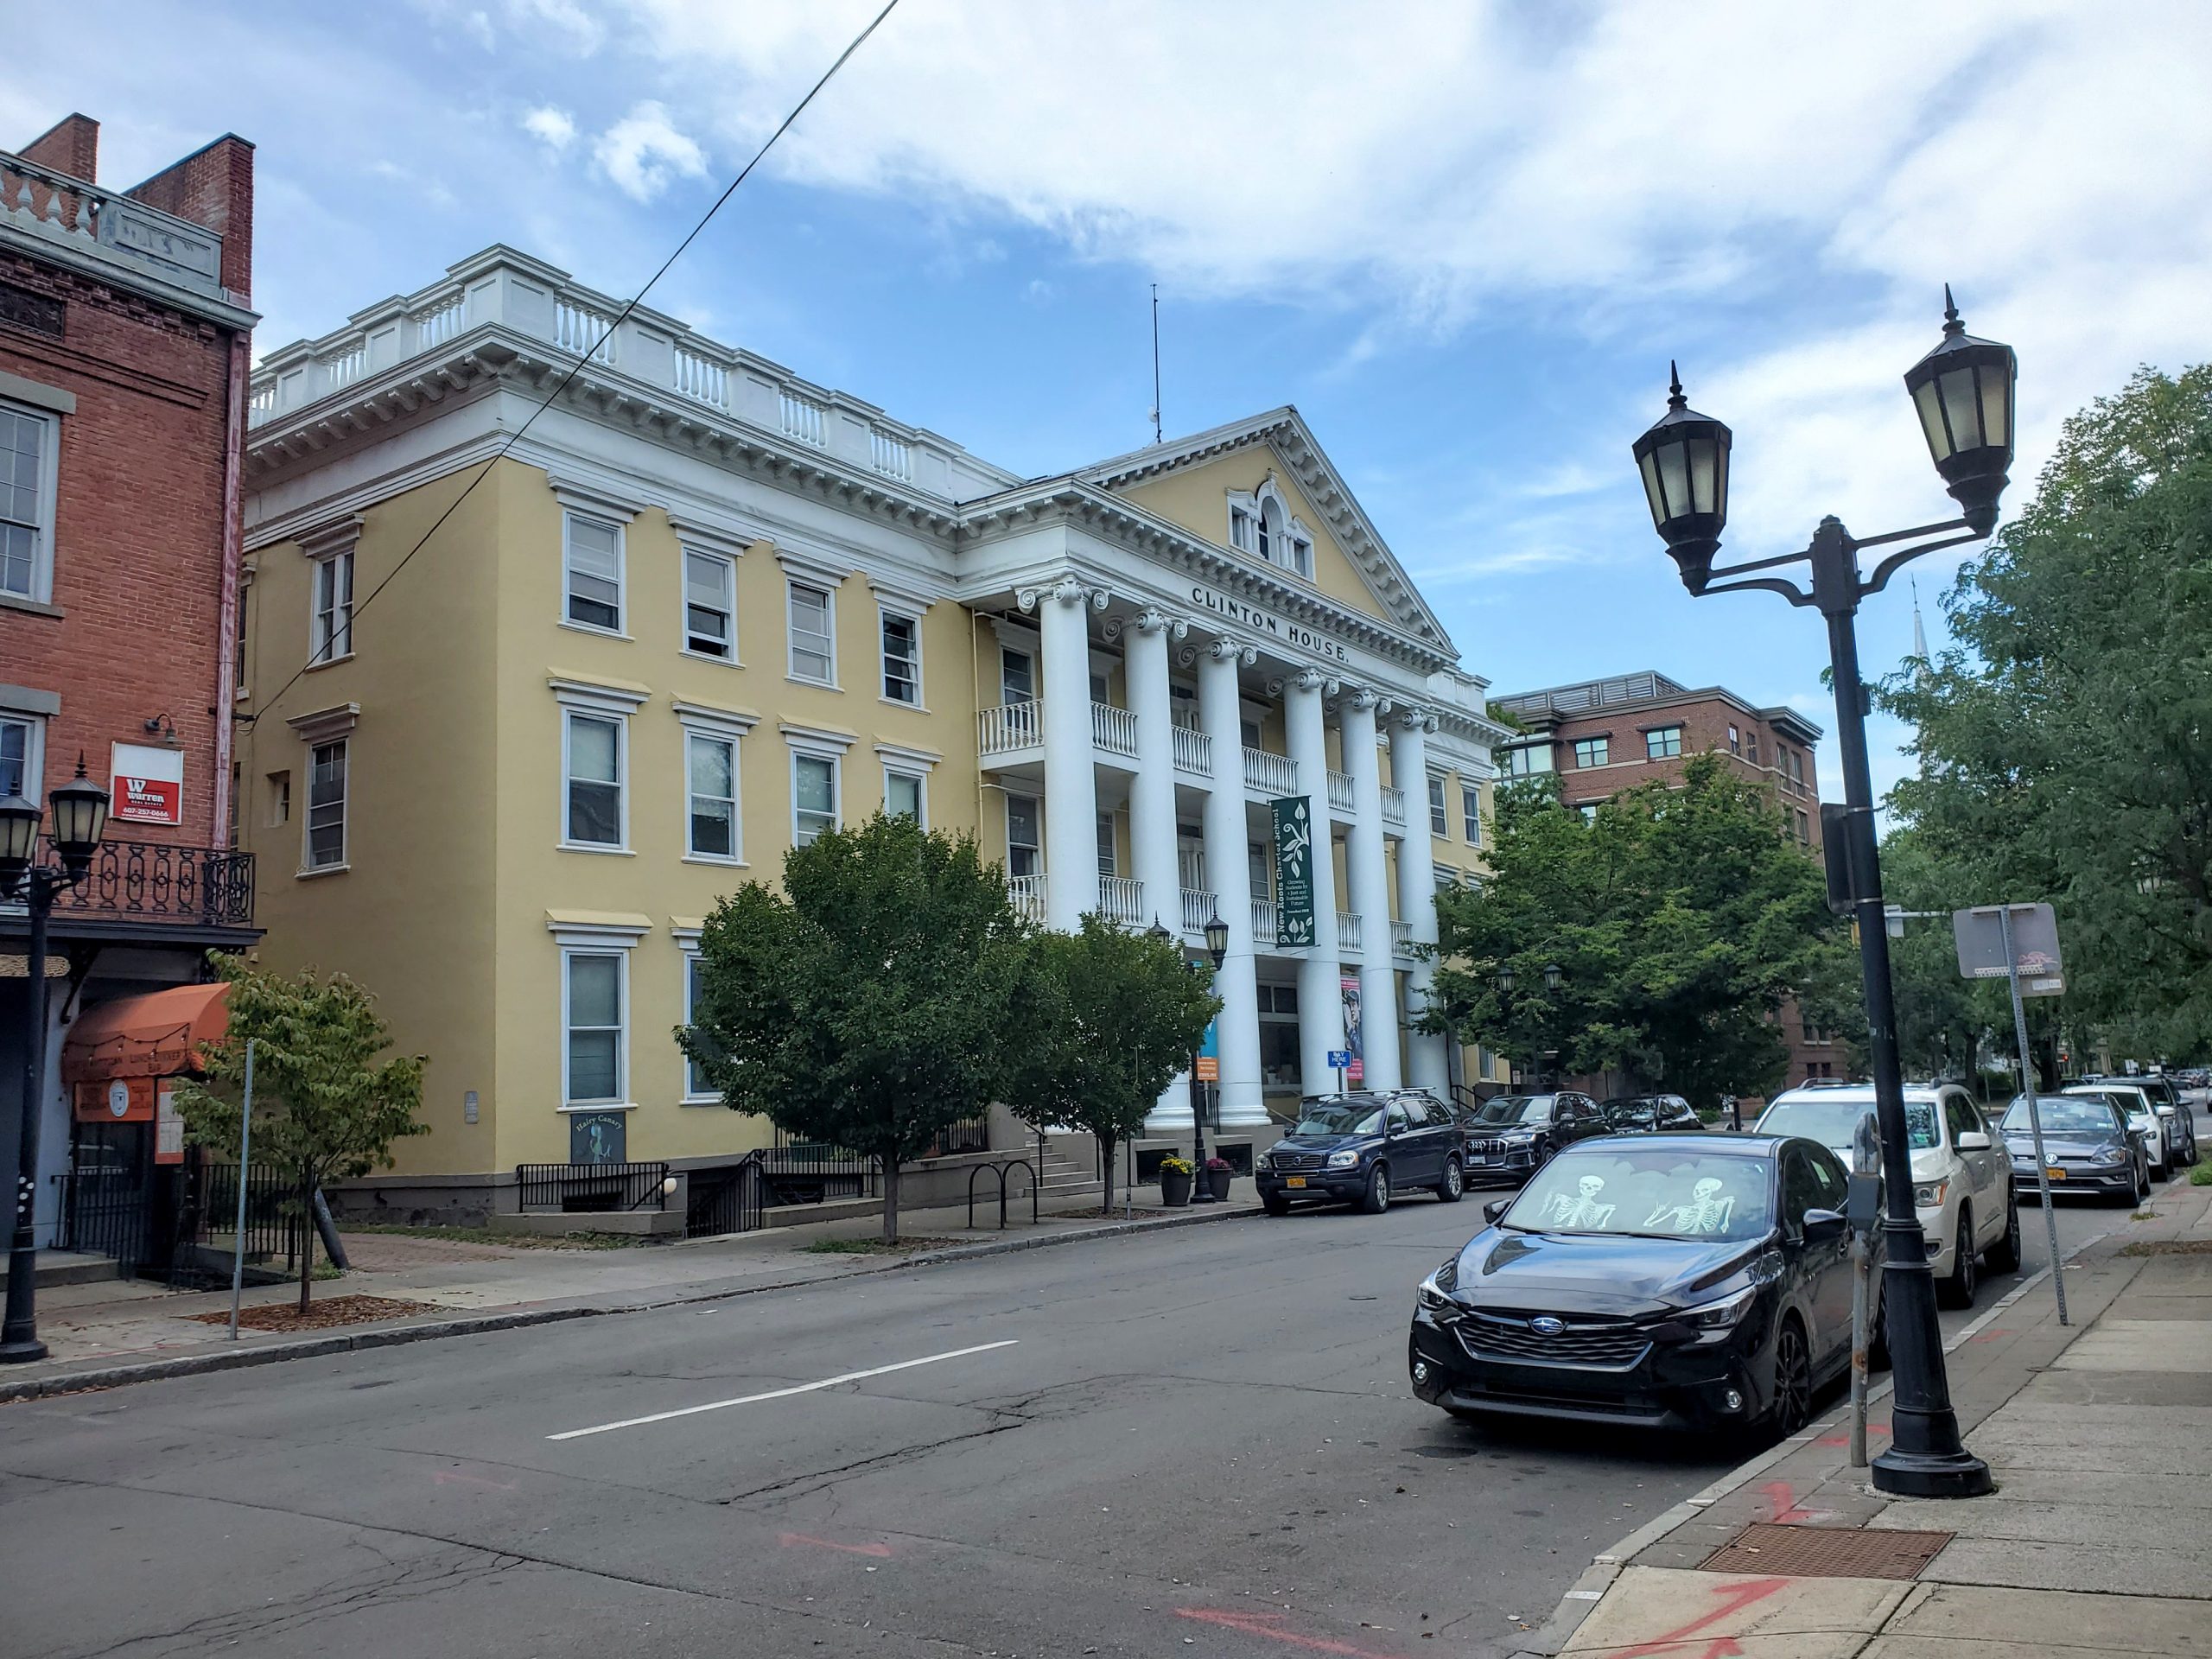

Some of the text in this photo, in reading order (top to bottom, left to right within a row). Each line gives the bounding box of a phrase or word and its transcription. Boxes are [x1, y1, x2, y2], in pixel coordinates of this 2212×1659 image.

[1192, 588, 1276, 633] CLINTON
[1272, 808, 1281, 840] School
[576, 1115, 622, 1132] Hairy Canary
